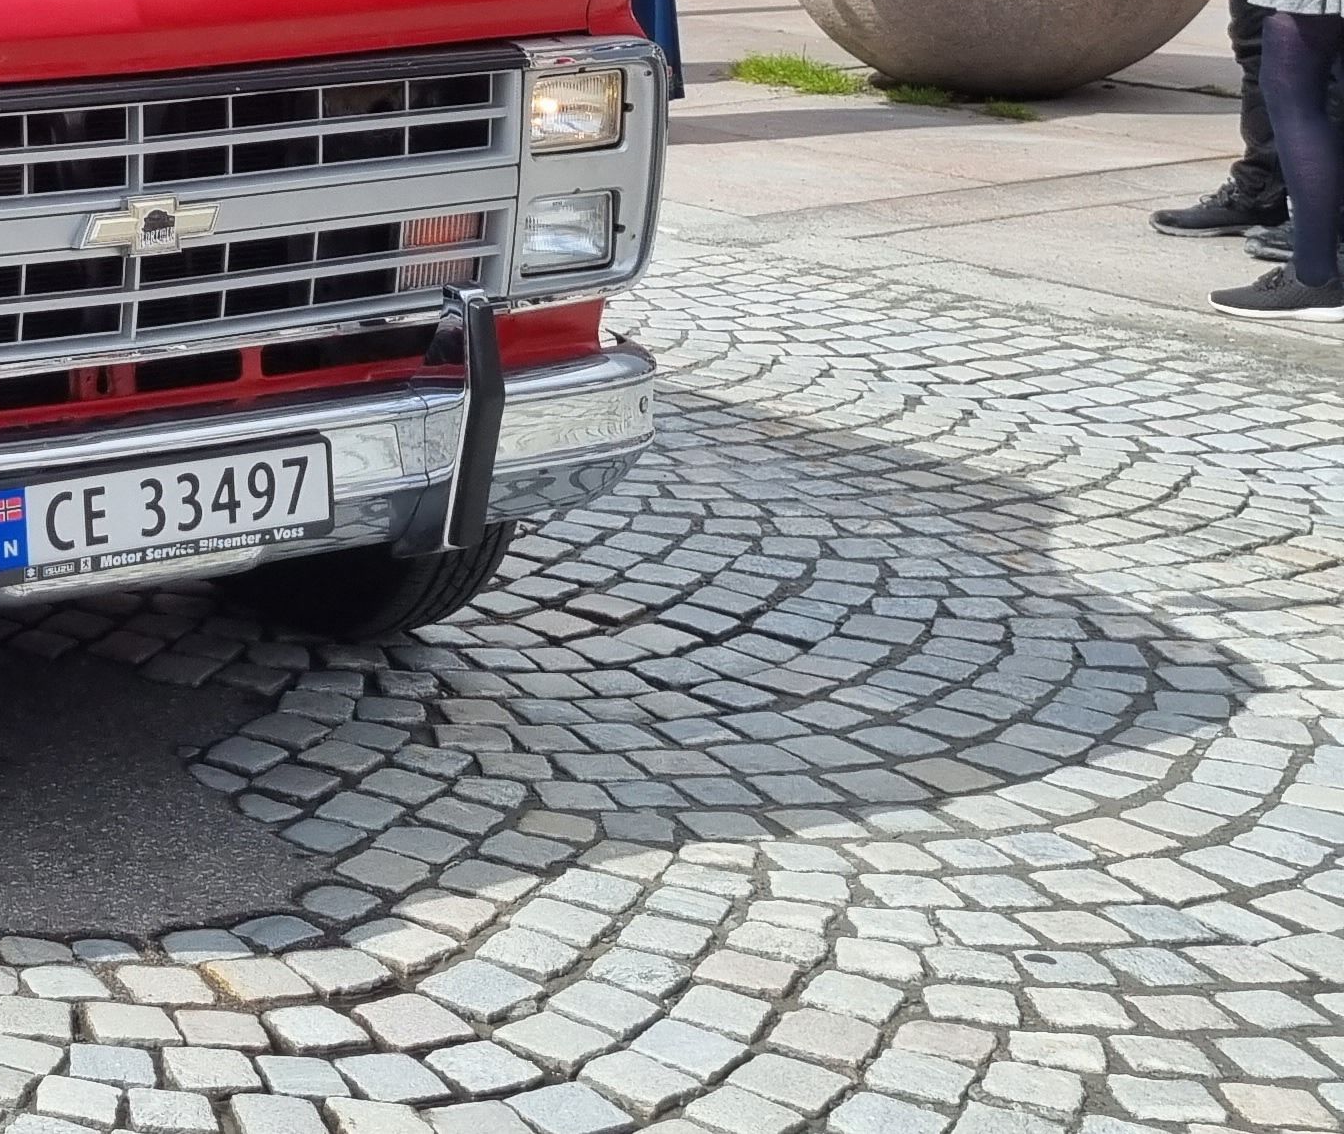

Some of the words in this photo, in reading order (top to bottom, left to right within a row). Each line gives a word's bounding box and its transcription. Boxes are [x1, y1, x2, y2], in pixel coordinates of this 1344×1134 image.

[45, 486, 109, 551] CE
[139, 455, 309, 538] 33497
[2, 540, 19, 558] N
[100, 552, 142, 569] Motor
[274, 525, 305, 540] Voss
[44, 563, 74, 577] ISUZU
